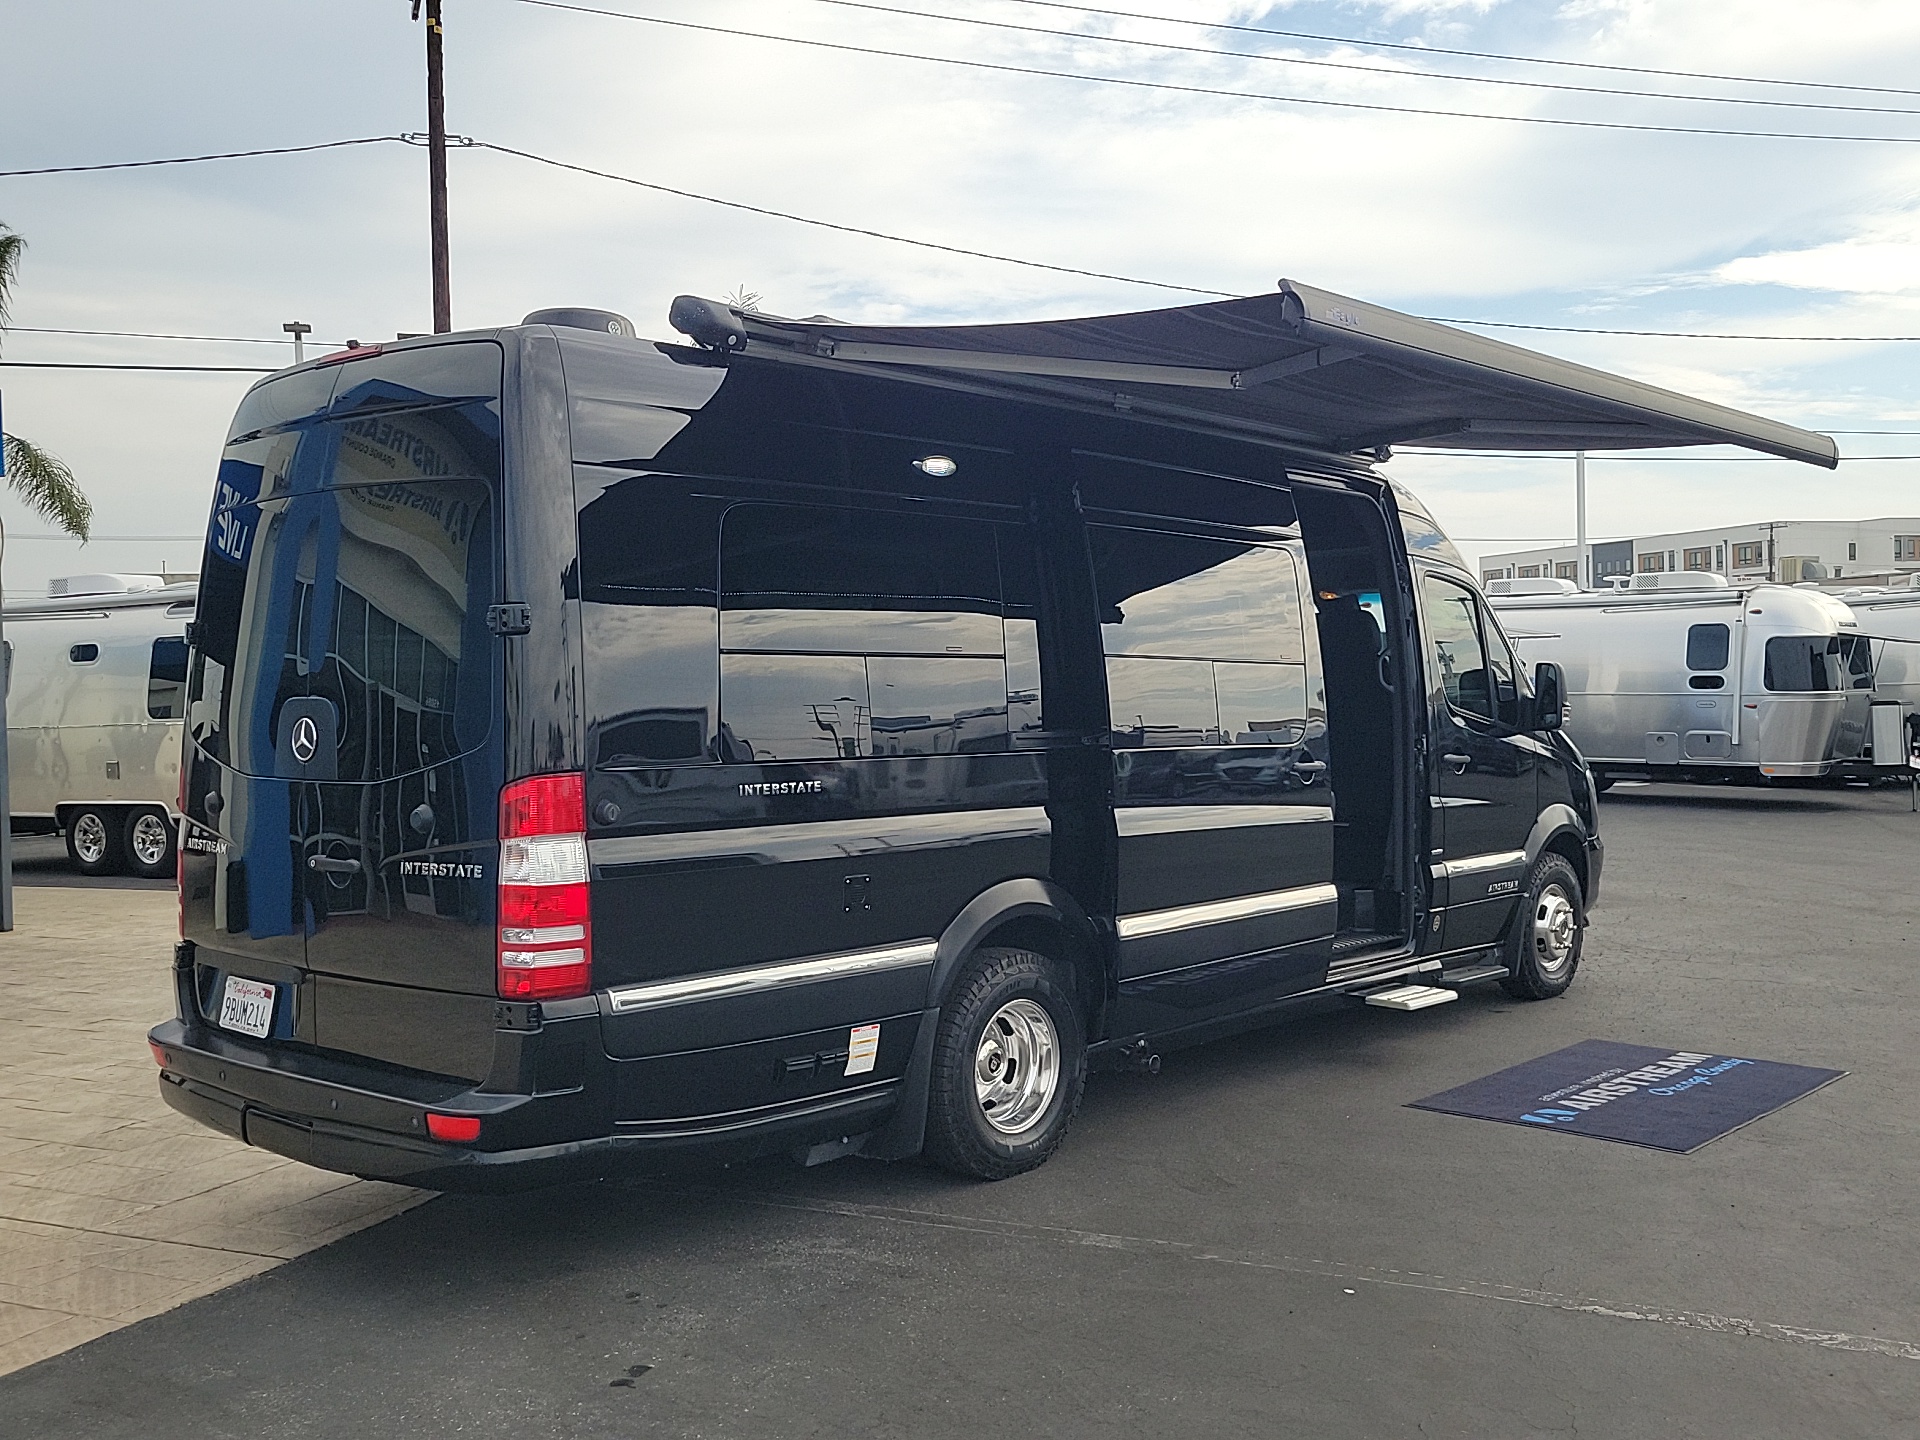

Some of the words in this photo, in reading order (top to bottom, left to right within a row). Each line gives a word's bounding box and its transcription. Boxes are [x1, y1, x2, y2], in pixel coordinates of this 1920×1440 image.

[739, 780, 822, 797] INTERSTATE
[187, 837, 228, 855] AIRSTREAM
[400, 861, 483, 879] INTERSTATE
[223, 996, 267, 1031] 9BUM214
[1557, 1051, 1714, 1111] AIRSTREAM
[1648, 1075, 1712, 1097] Orange
[1694, 1057, 1755, 1077] County
